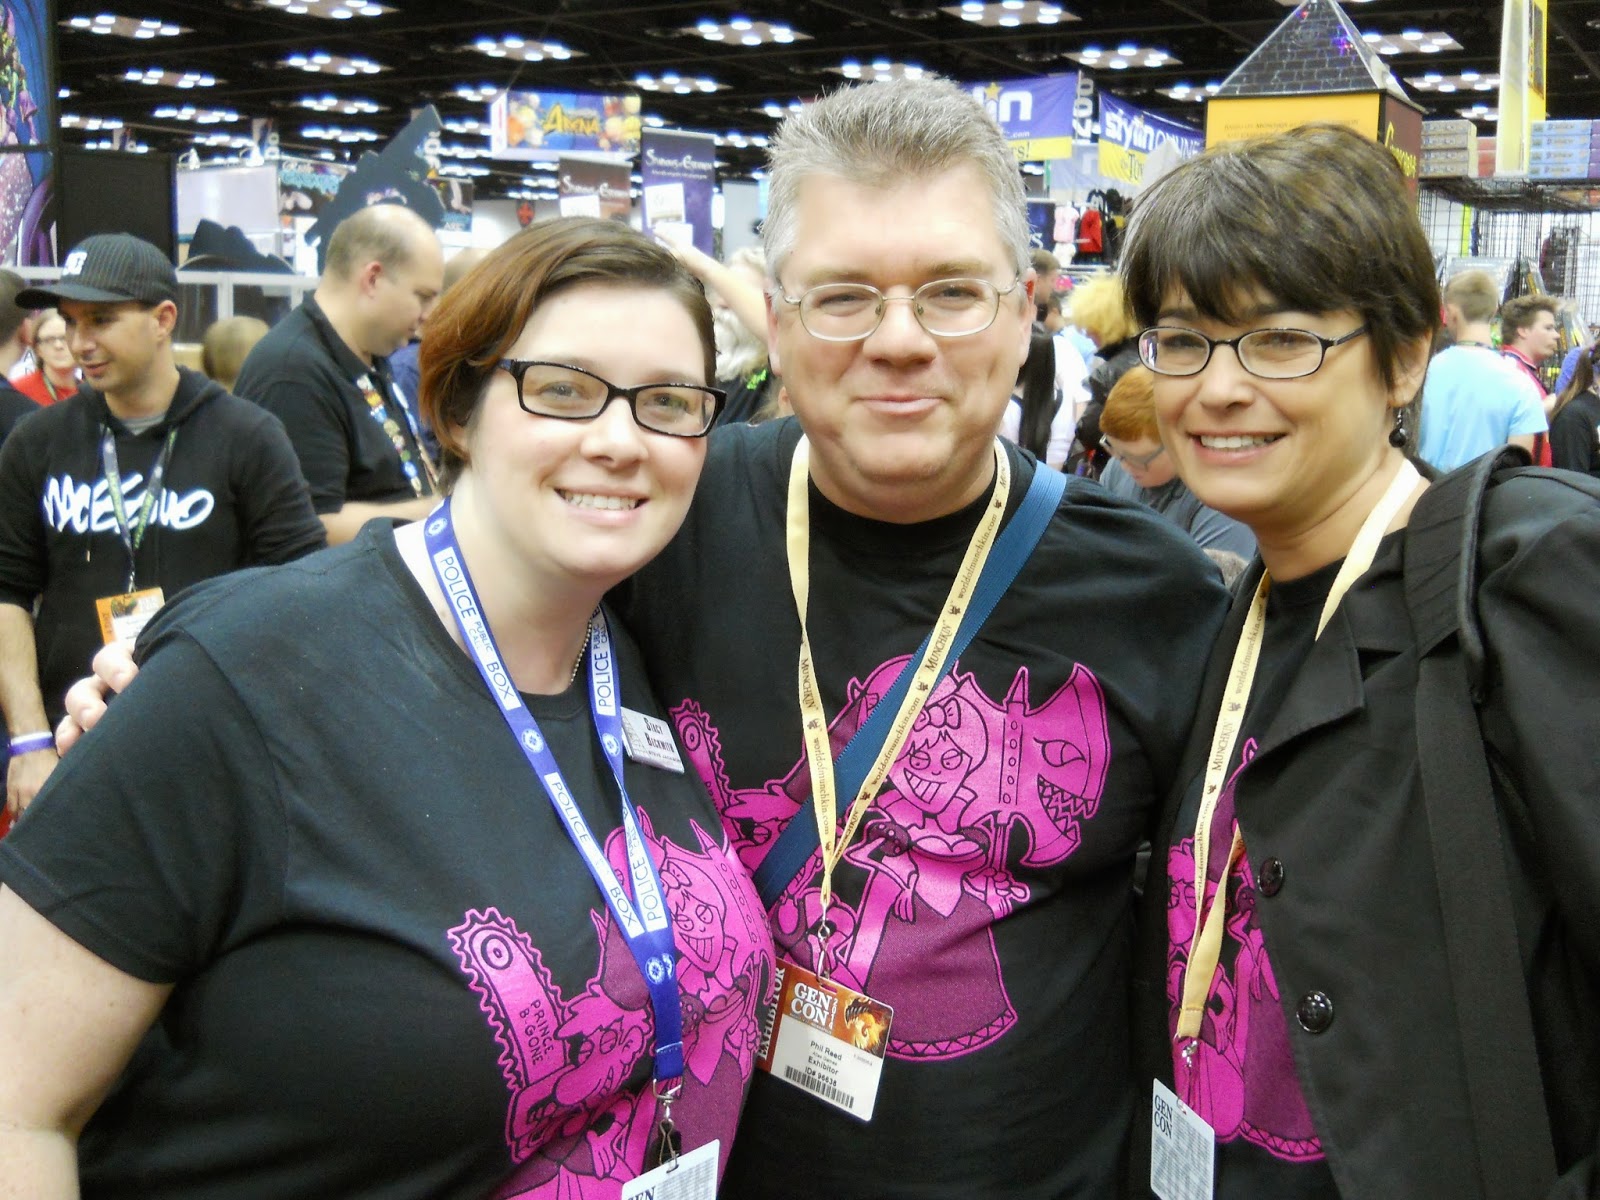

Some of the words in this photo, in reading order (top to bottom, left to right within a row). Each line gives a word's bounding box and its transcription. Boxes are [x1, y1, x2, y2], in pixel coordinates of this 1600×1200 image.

[957, 513, 997, 600] worldofmunchkin.com
[440, 556, 478, 619] POLICE
[474, 620, 494, 653] PUBLIC
[486, 660, 515, 700] BOX
[924, 622, 953, 673] MUNCHKIN
[594, 651, 613, 708] POLICE
[800, 657, 817, 710] MUNCHKIN
[872, 696, 921, 786] worldofmunchkin.com
[1211, 719, 1236, 772] MUNCHKIN
[813, 736, 830, 836] worldofmunchkin.com
[551, 780, 592, 844] POLICE
[609, 886, 639, 928] BOX
[632, 857, 663, 923] POLICE
[791, 998, 830, 1026] CON
[794, 982, 833, 1011] GEN
[804, 1066, 816, 1077] ID#
[807, 1056, 840, 1076] Exhibitor
[810, 1040, 824, 1052] Phil
[1153, 1111, 1173, 1139] CON
[1154, 1094, 1174, 1122] GEN
